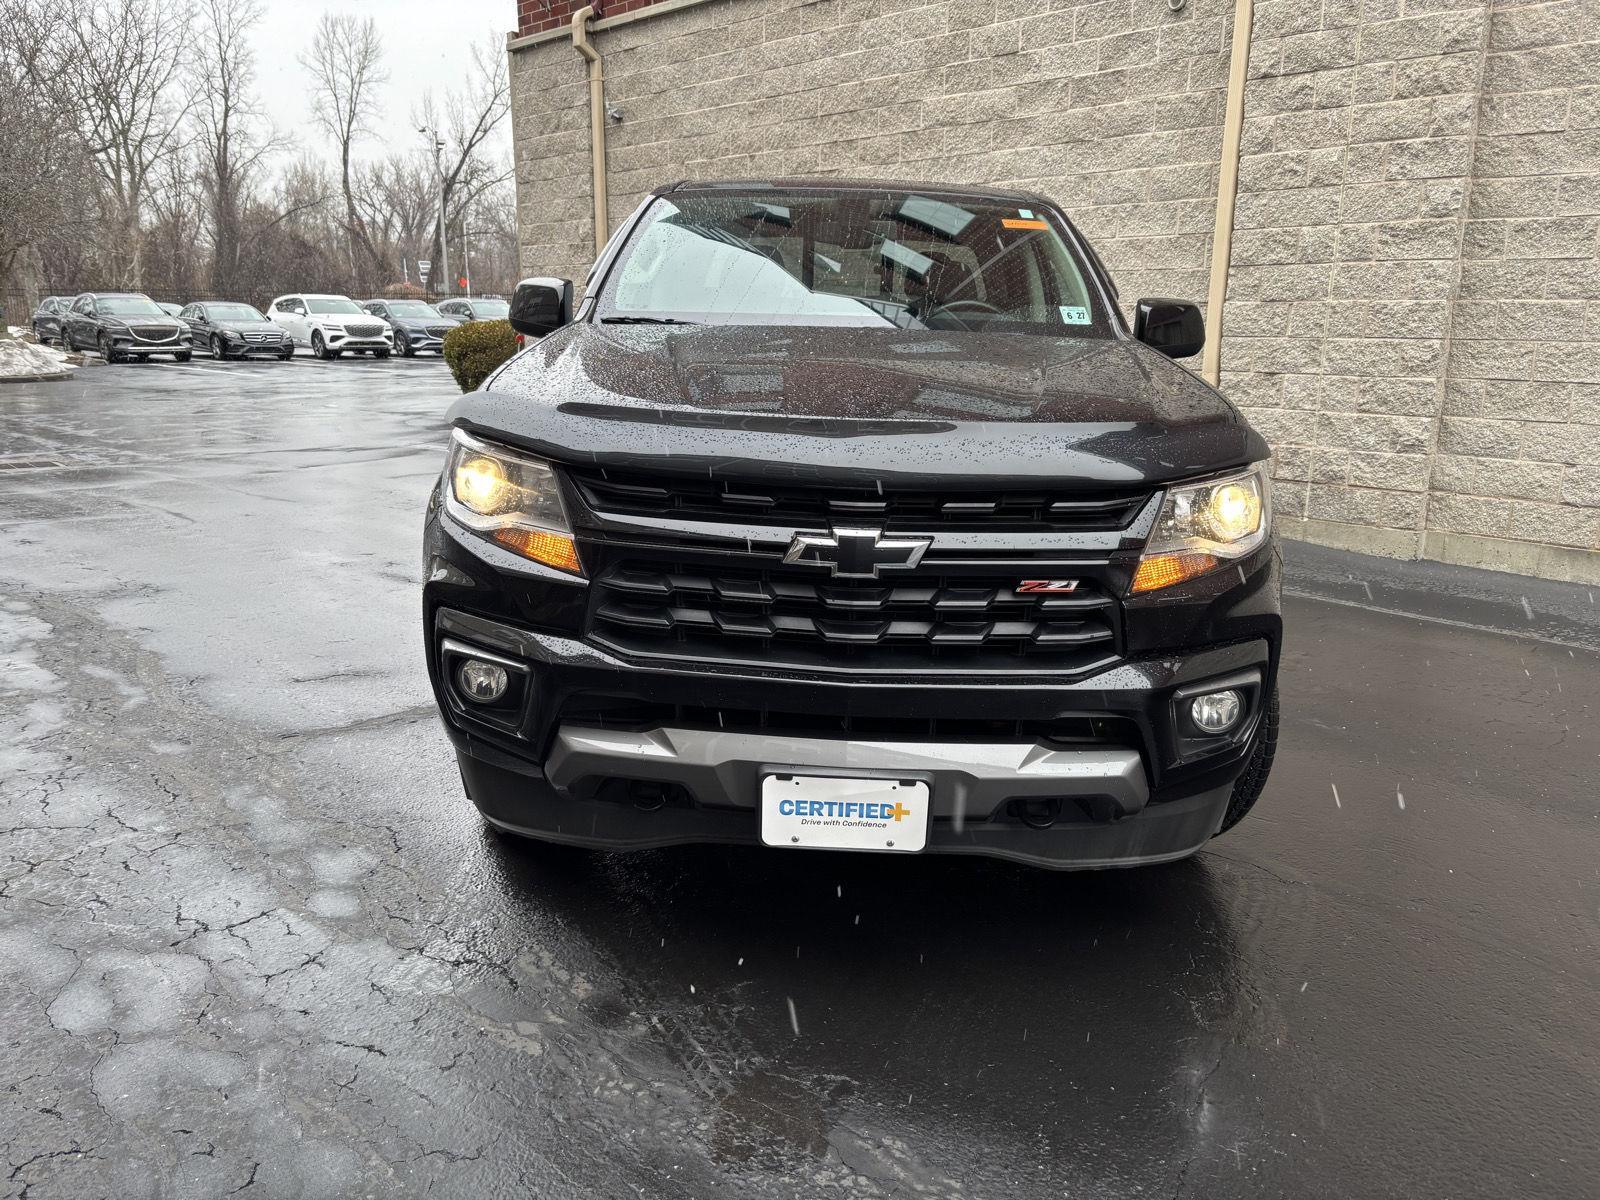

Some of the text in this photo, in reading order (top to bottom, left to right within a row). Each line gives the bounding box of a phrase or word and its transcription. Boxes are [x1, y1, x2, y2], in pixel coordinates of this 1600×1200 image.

[1066, 312, 1085, 320] 6 27
[801, 818, 887, 829] Drive with Confidence
